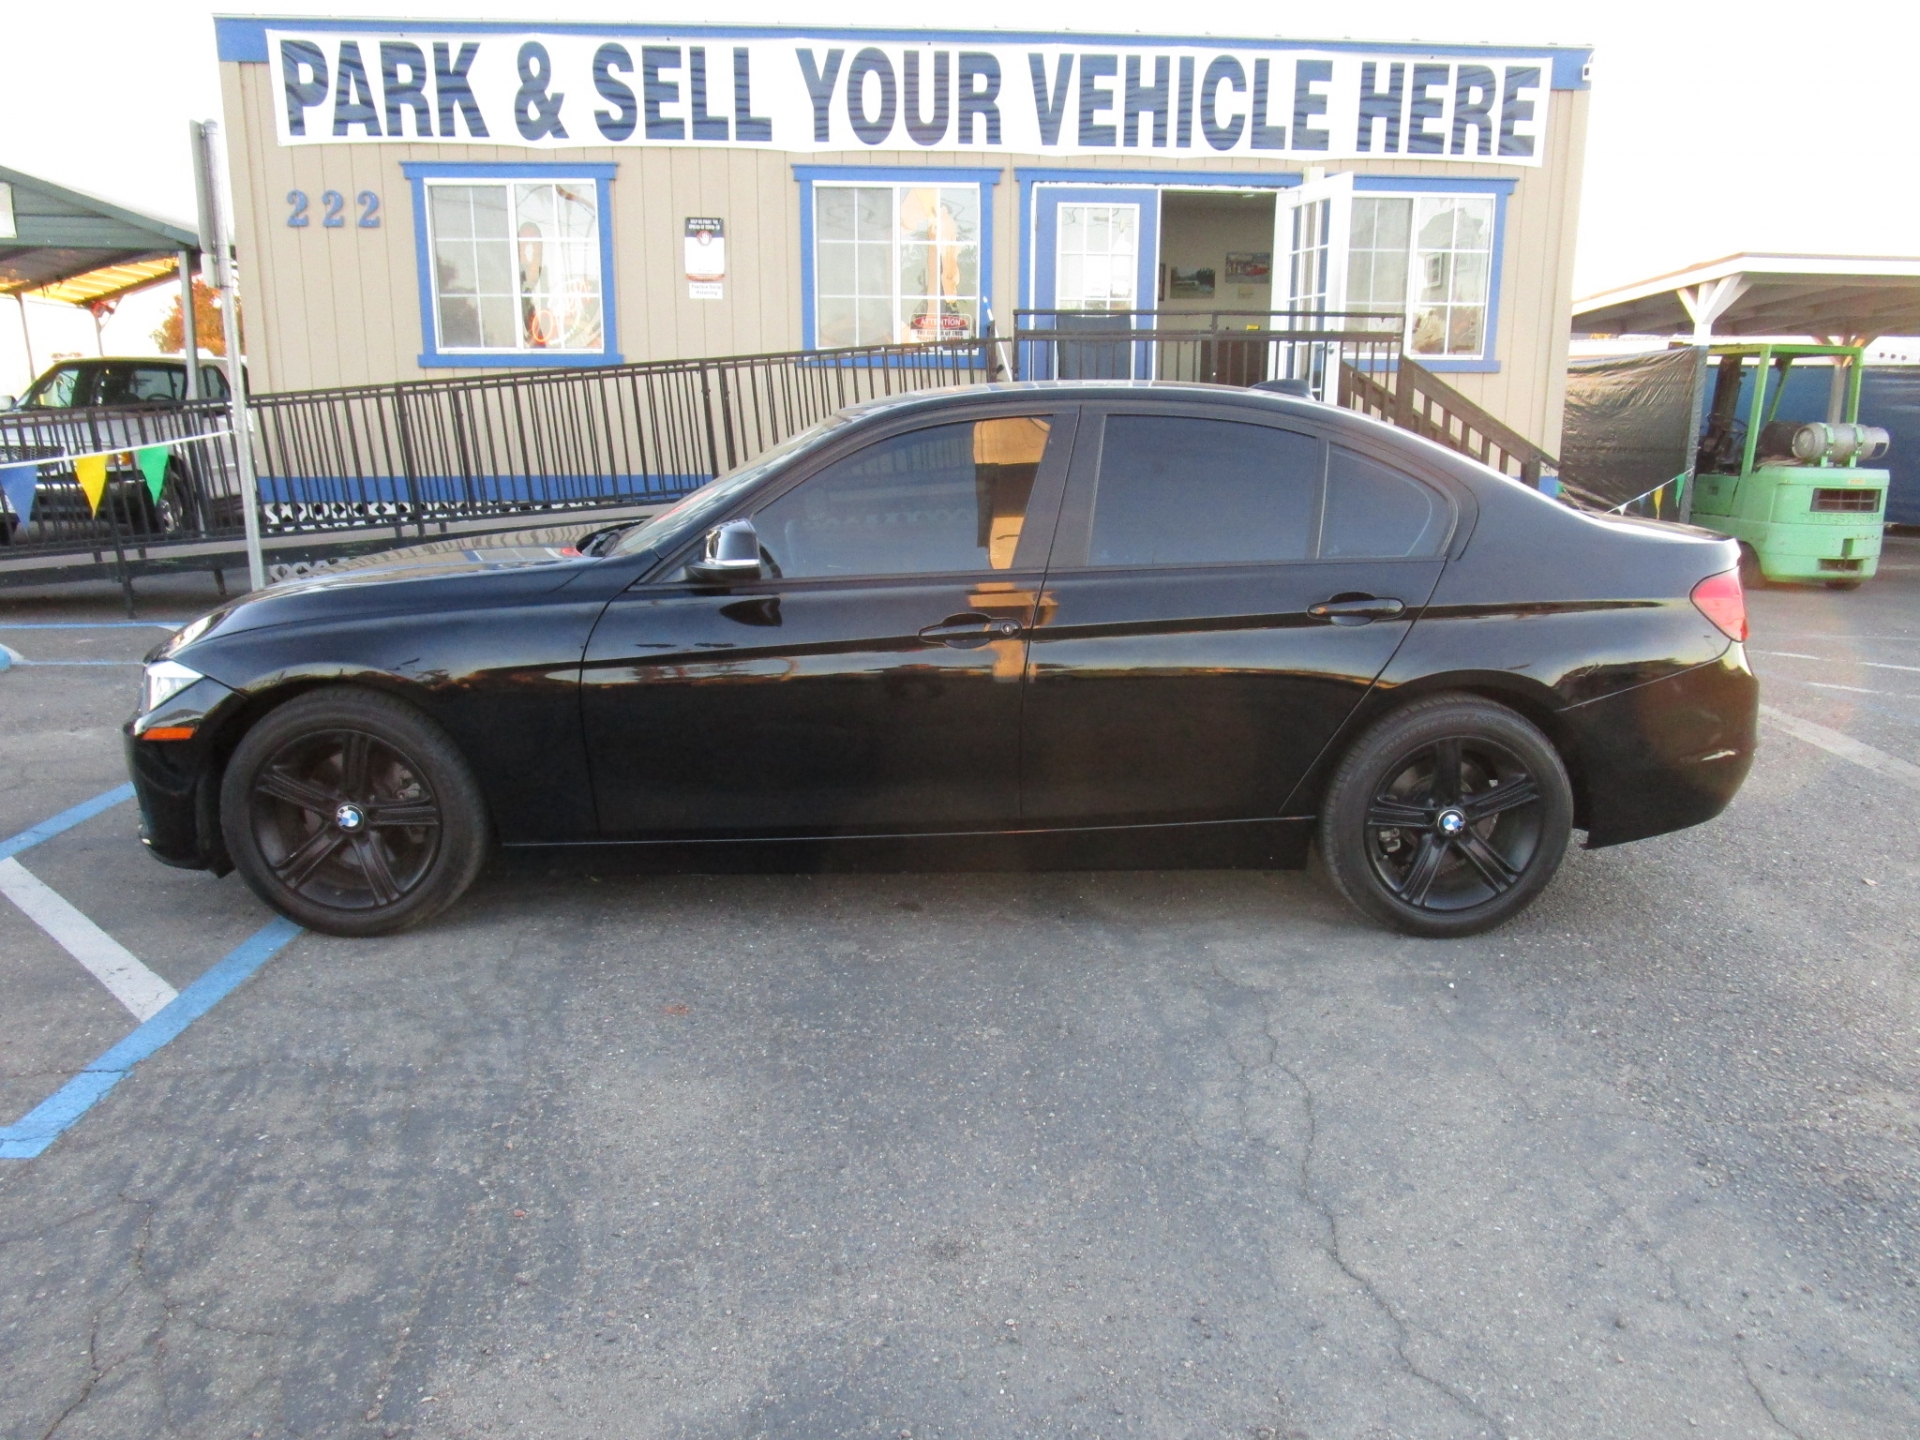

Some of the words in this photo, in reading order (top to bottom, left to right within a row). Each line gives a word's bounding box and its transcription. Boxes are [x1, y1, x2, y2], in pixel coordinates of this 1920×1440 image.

[280, 39, 490, 137] PARK
[514, 41, 569, 141] &
[592, 42, 772, 142] SELL
[795, 47, 1002, 146] YOUR
[1028, 53, 1333, 151] VEHICLE
[1356, 61, 1541, 156] HERE
[286, 189, 380, 228] 222
